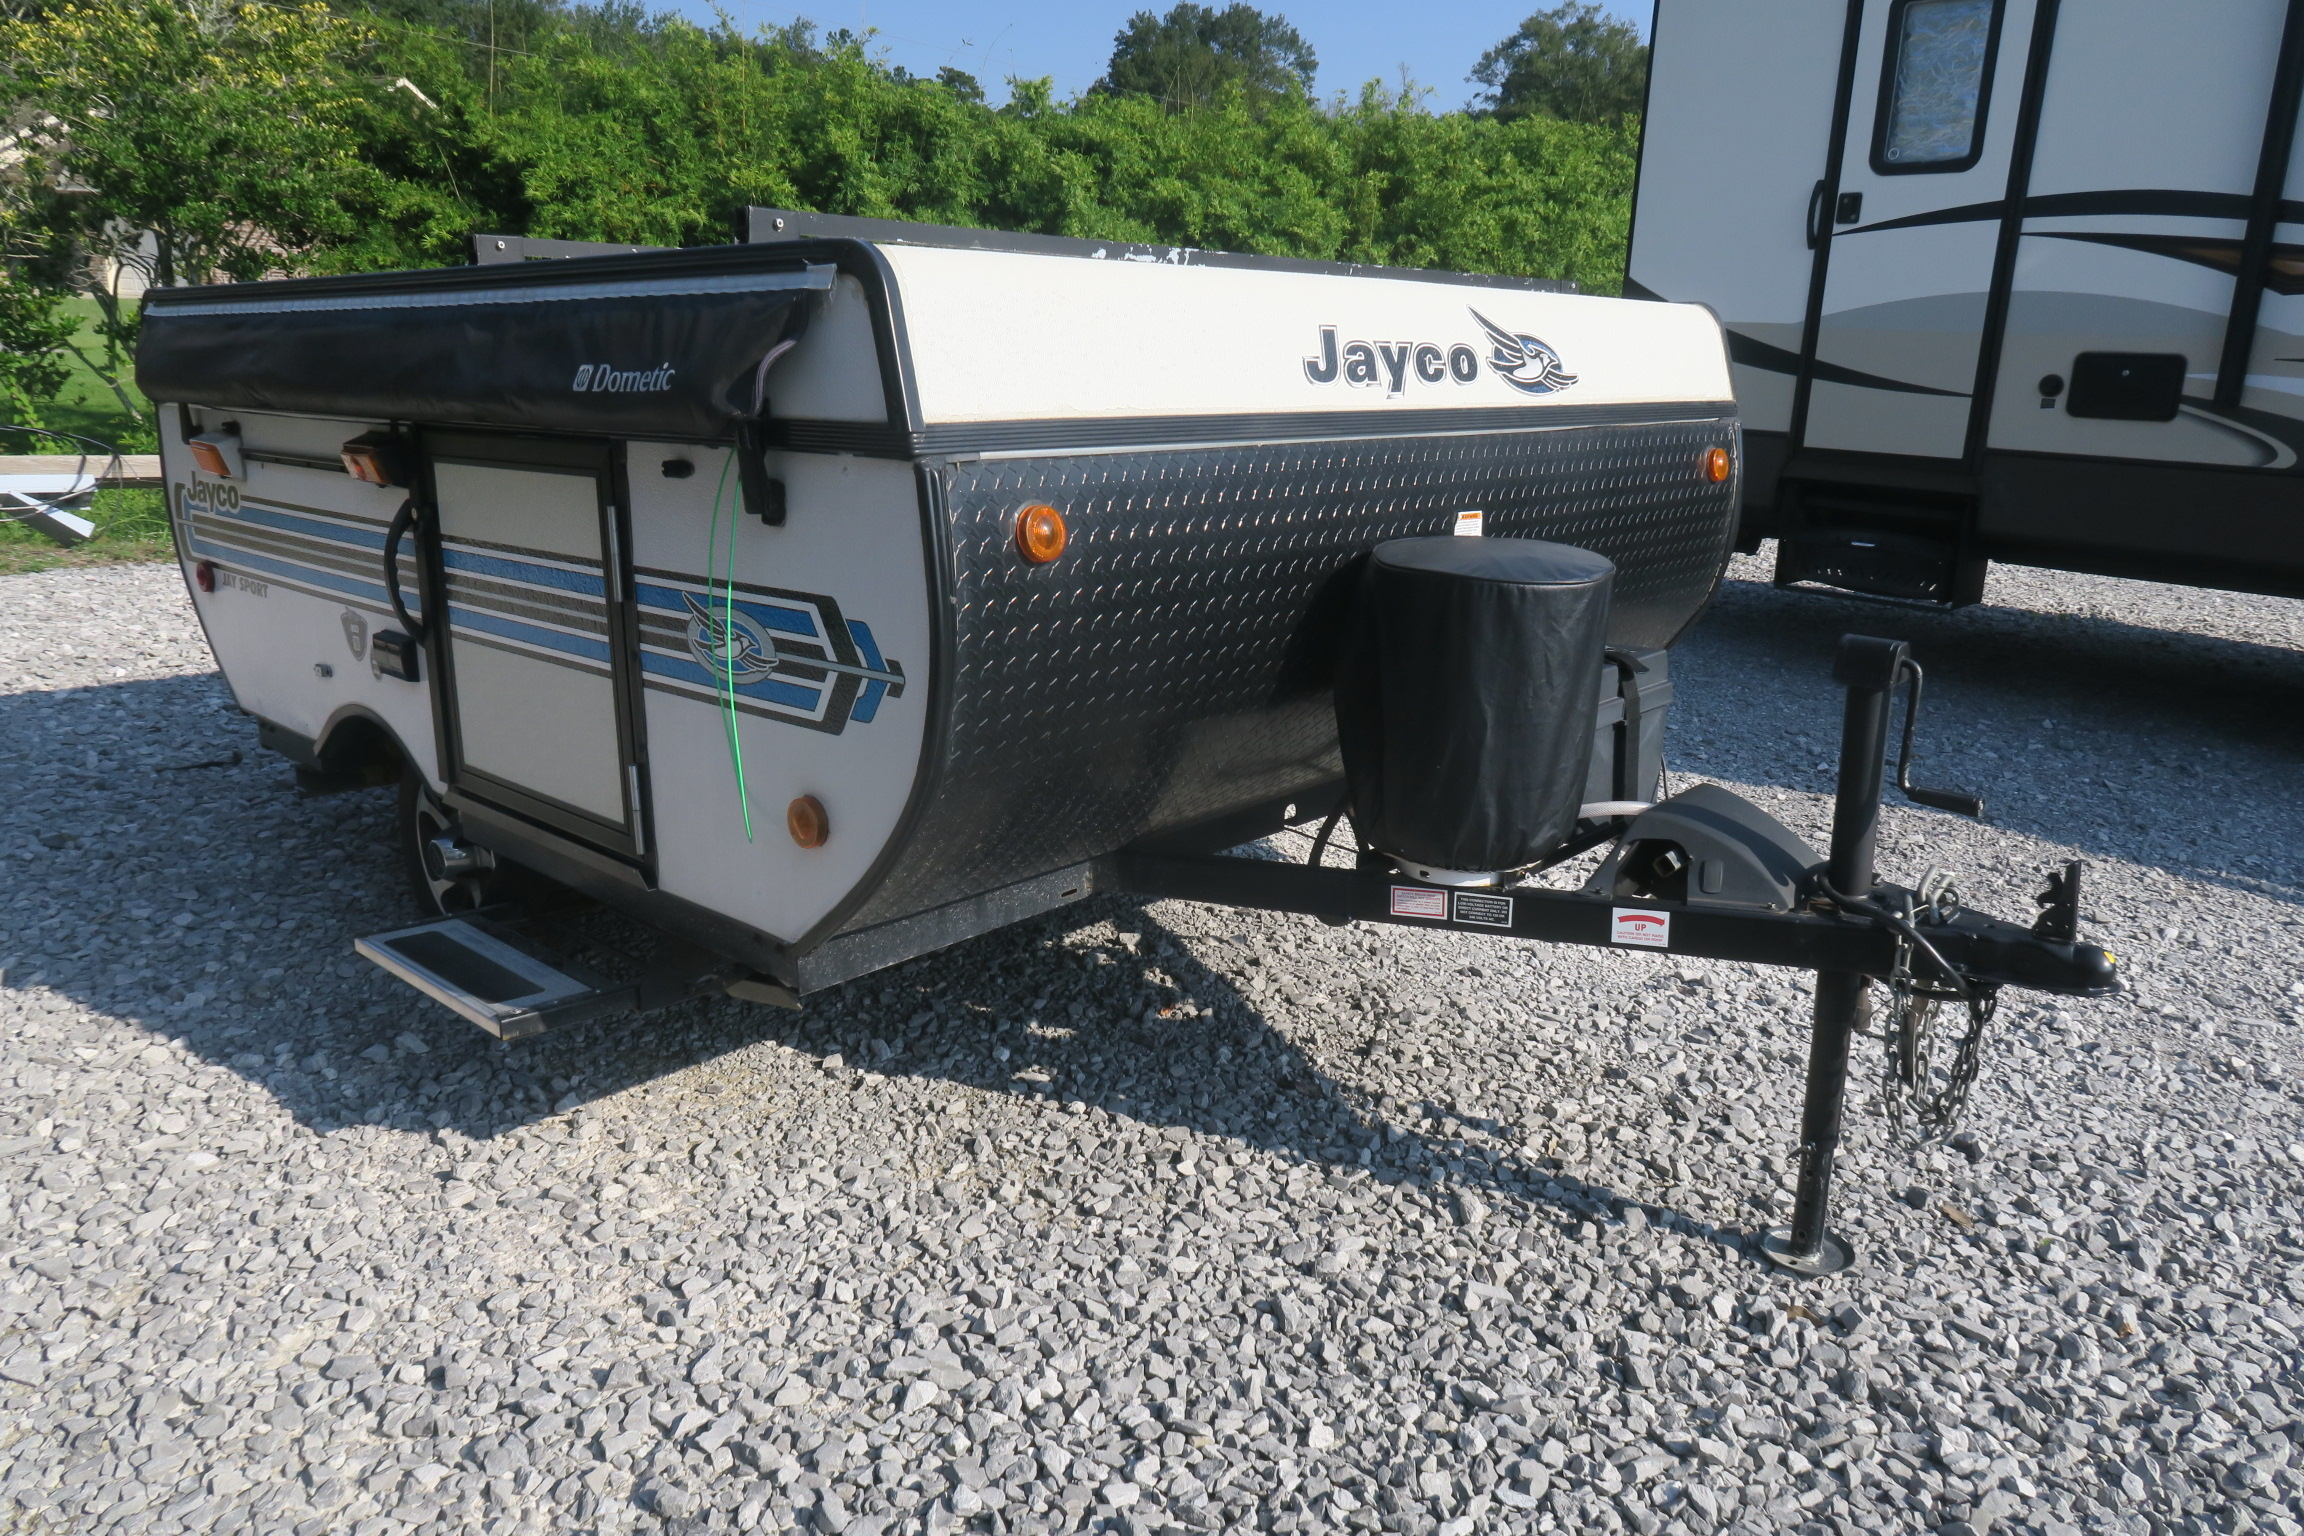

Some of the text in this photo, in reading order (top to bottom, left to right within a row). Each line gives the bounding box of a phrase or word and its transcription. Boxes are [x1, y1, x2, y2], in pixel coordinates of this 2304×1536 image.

[592, 362, 675, 392] Dometic
[1302, 325, 1481, 399] Jayco
[187, 470, 239, 512] Jayco
[223, 572, 268, 598] JAY SPORT
[1634, 923, 1647, 931] UP
